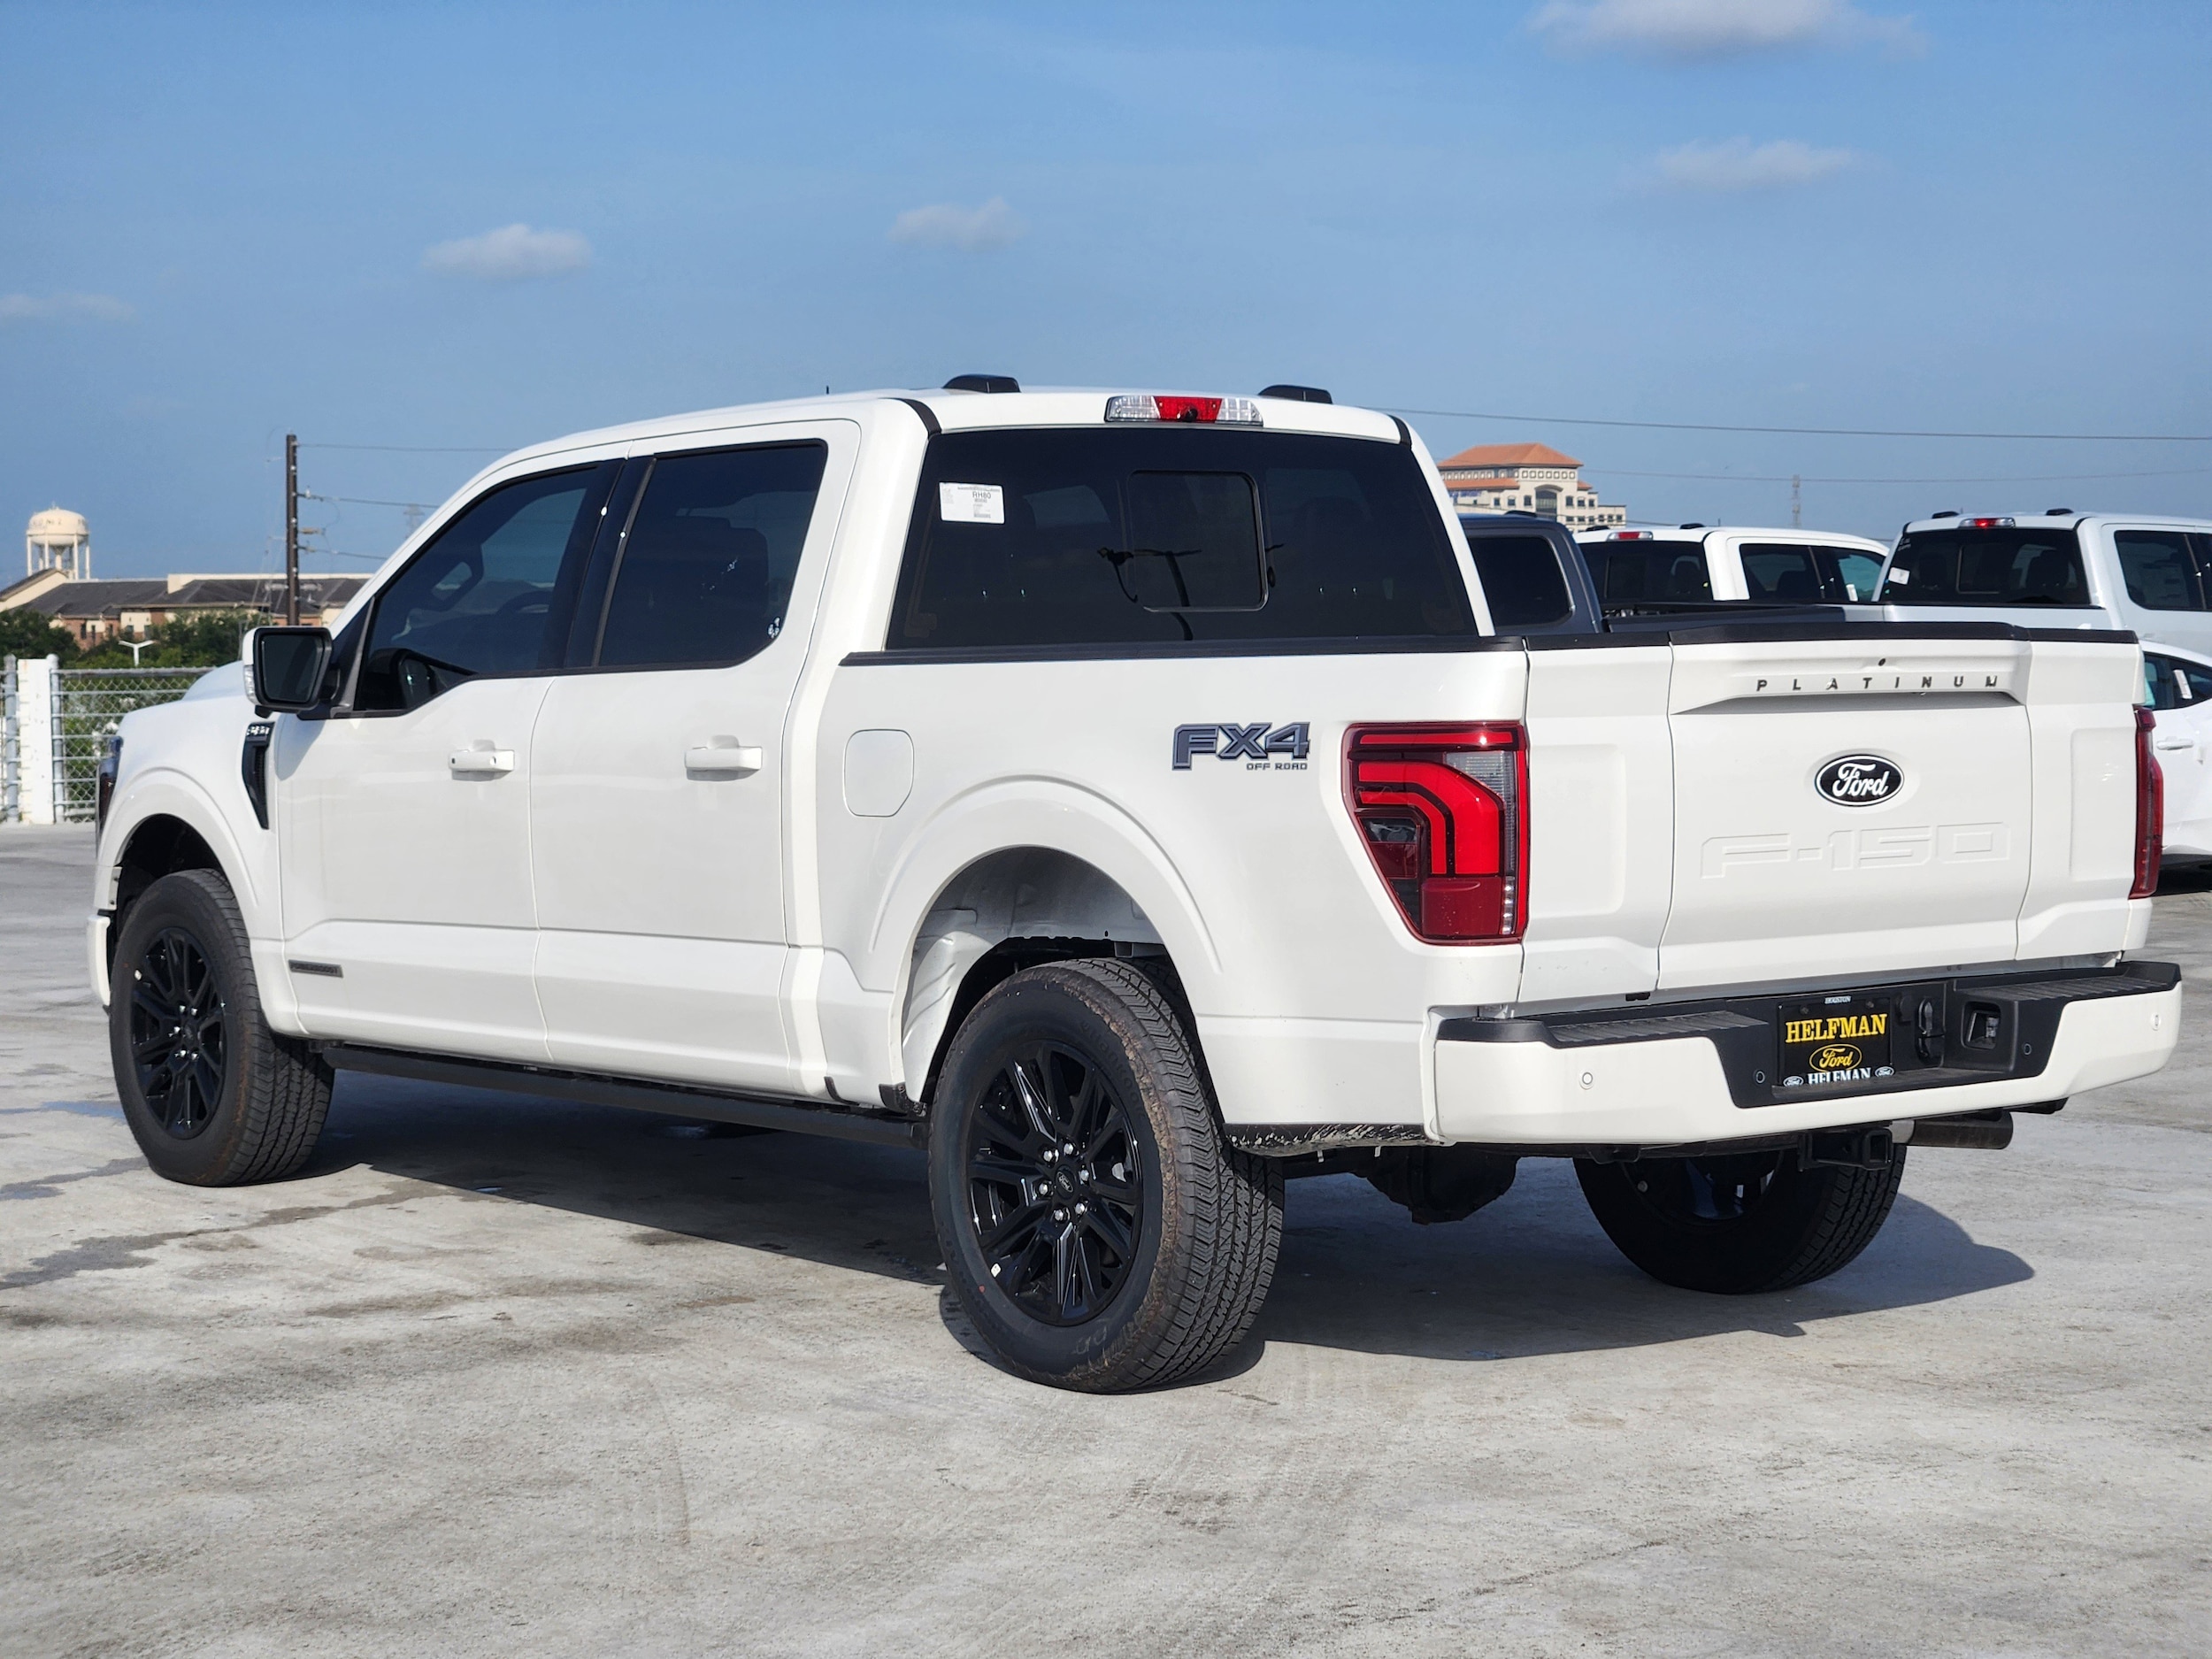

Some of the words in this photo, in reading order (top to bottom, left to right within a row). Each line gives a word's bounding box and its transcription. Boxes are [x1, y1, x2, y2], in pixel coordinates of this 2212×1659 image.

[1756, 675, 1997, 691] PLATINUM
[1171, 722, 1310, 770] FX4
[1832, 763, 1889, 796] Ford
[1701, 822, 2010, 879] F-150
[1786, 1014, 1887, 1042] HELFMAN
[1819, 1048, 1854, 1068] Ford
